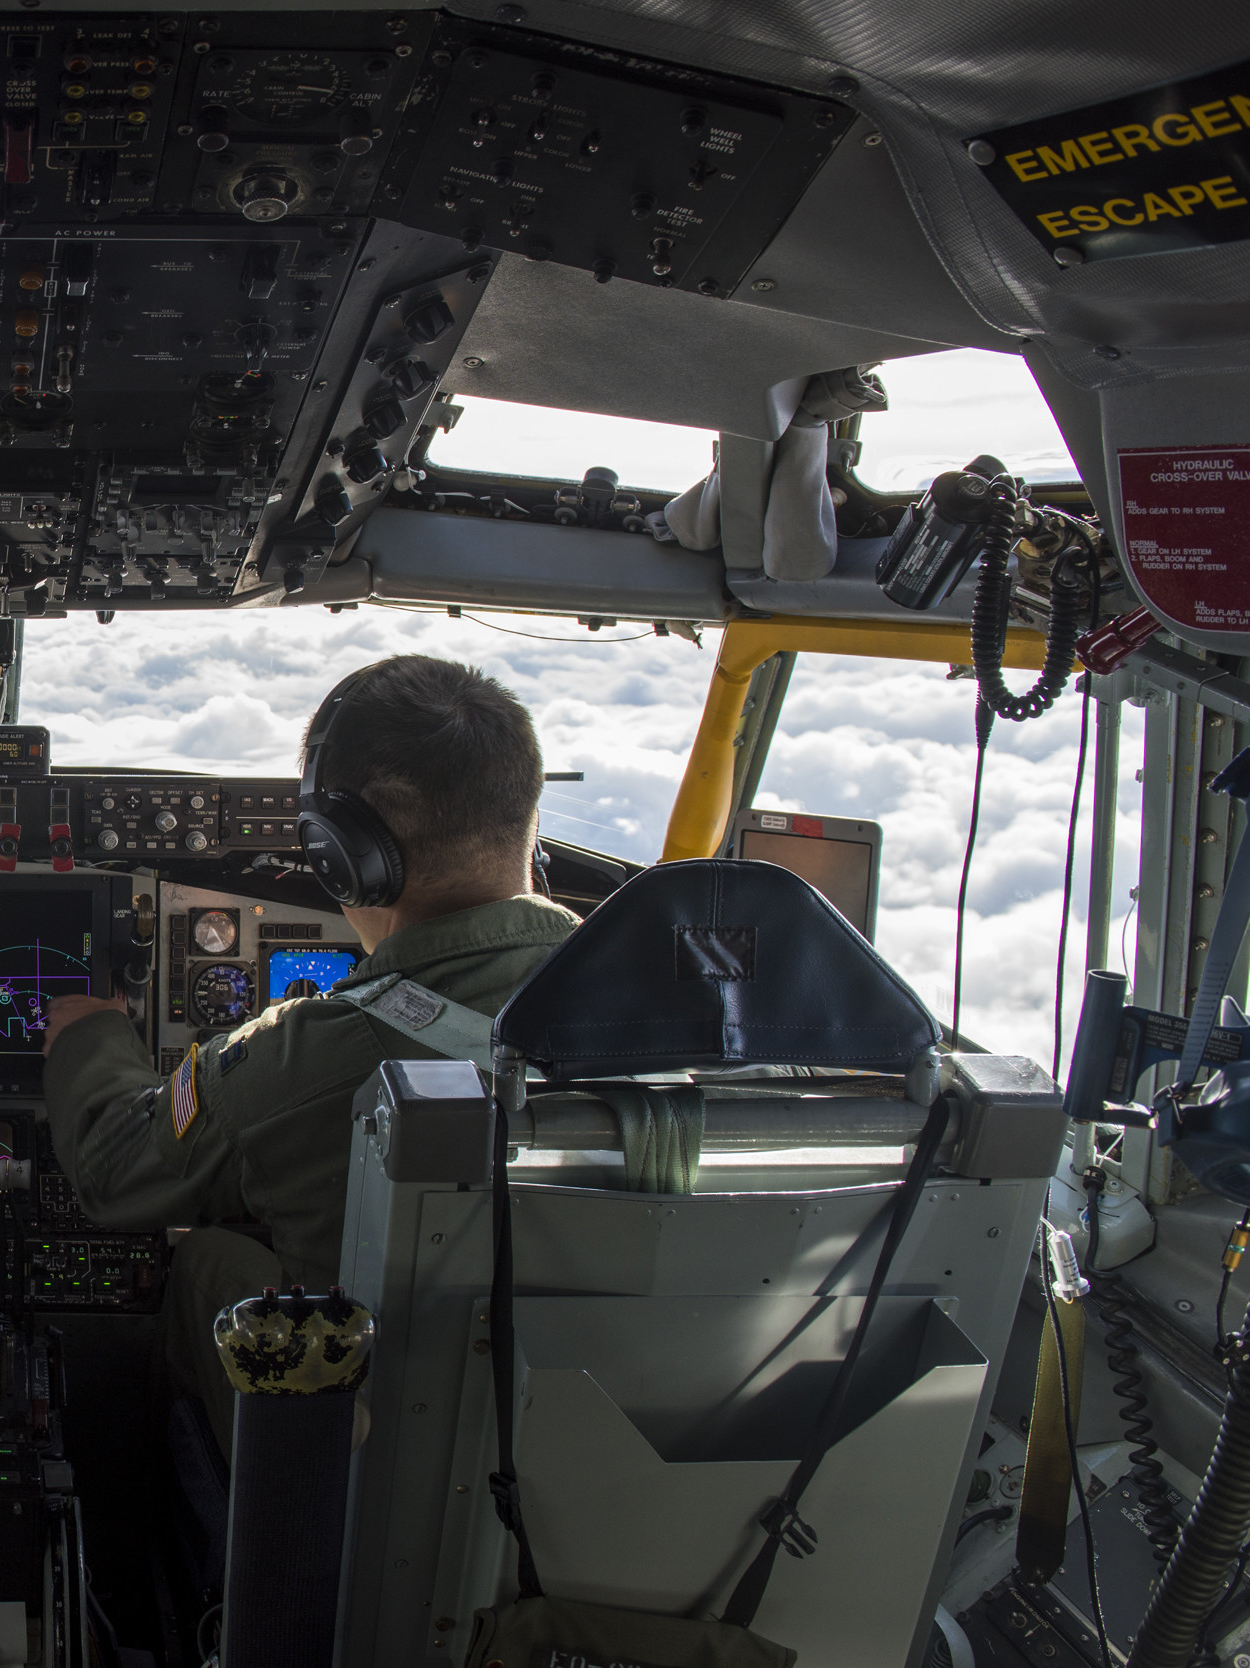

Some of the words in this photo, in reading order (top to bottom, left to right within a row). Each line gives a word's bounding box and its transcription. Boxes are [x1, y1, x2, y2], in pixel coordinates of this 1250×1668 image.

[553, 104, 587, 118] LIGHTS
[710, 127, 742, 141] WHEEL
[710, 135, 735, 147] WELL
[700, 141, 735, 155] LIGHTS
[450, 165, 499, 184] NAVIGATI
[512, 181, 545, 194] LIGHTS
[720, 173, 737, 181] OFF
[673, 205, 695, 215] FIRE
[1036, 175, 1248, 238] ESCAPE
[656, 209, 704, 224] DETECTOR
[666, 218, 689, 228] TEST
[1173, 459, 1234, 471] HYDRAULIC
[1150, 471, 1223, 483] CROSS-OVER
[1149, 507, 1169, 515] GEAR
[1171, 507, 1180, 515] TO
[1182, 507, 1193, 515] RH
[1195, 507, 1225, 515] SYSTEM
[1183, 548, 1212, 556] SYSTEM
[1164, 555, 1187, 563] BOOM
[1142, 562, 1170, 570] RUDDER
[1197, 563, 1227, 571] SYSTEM
[1195, 616, 1225, 624] RUDDER
